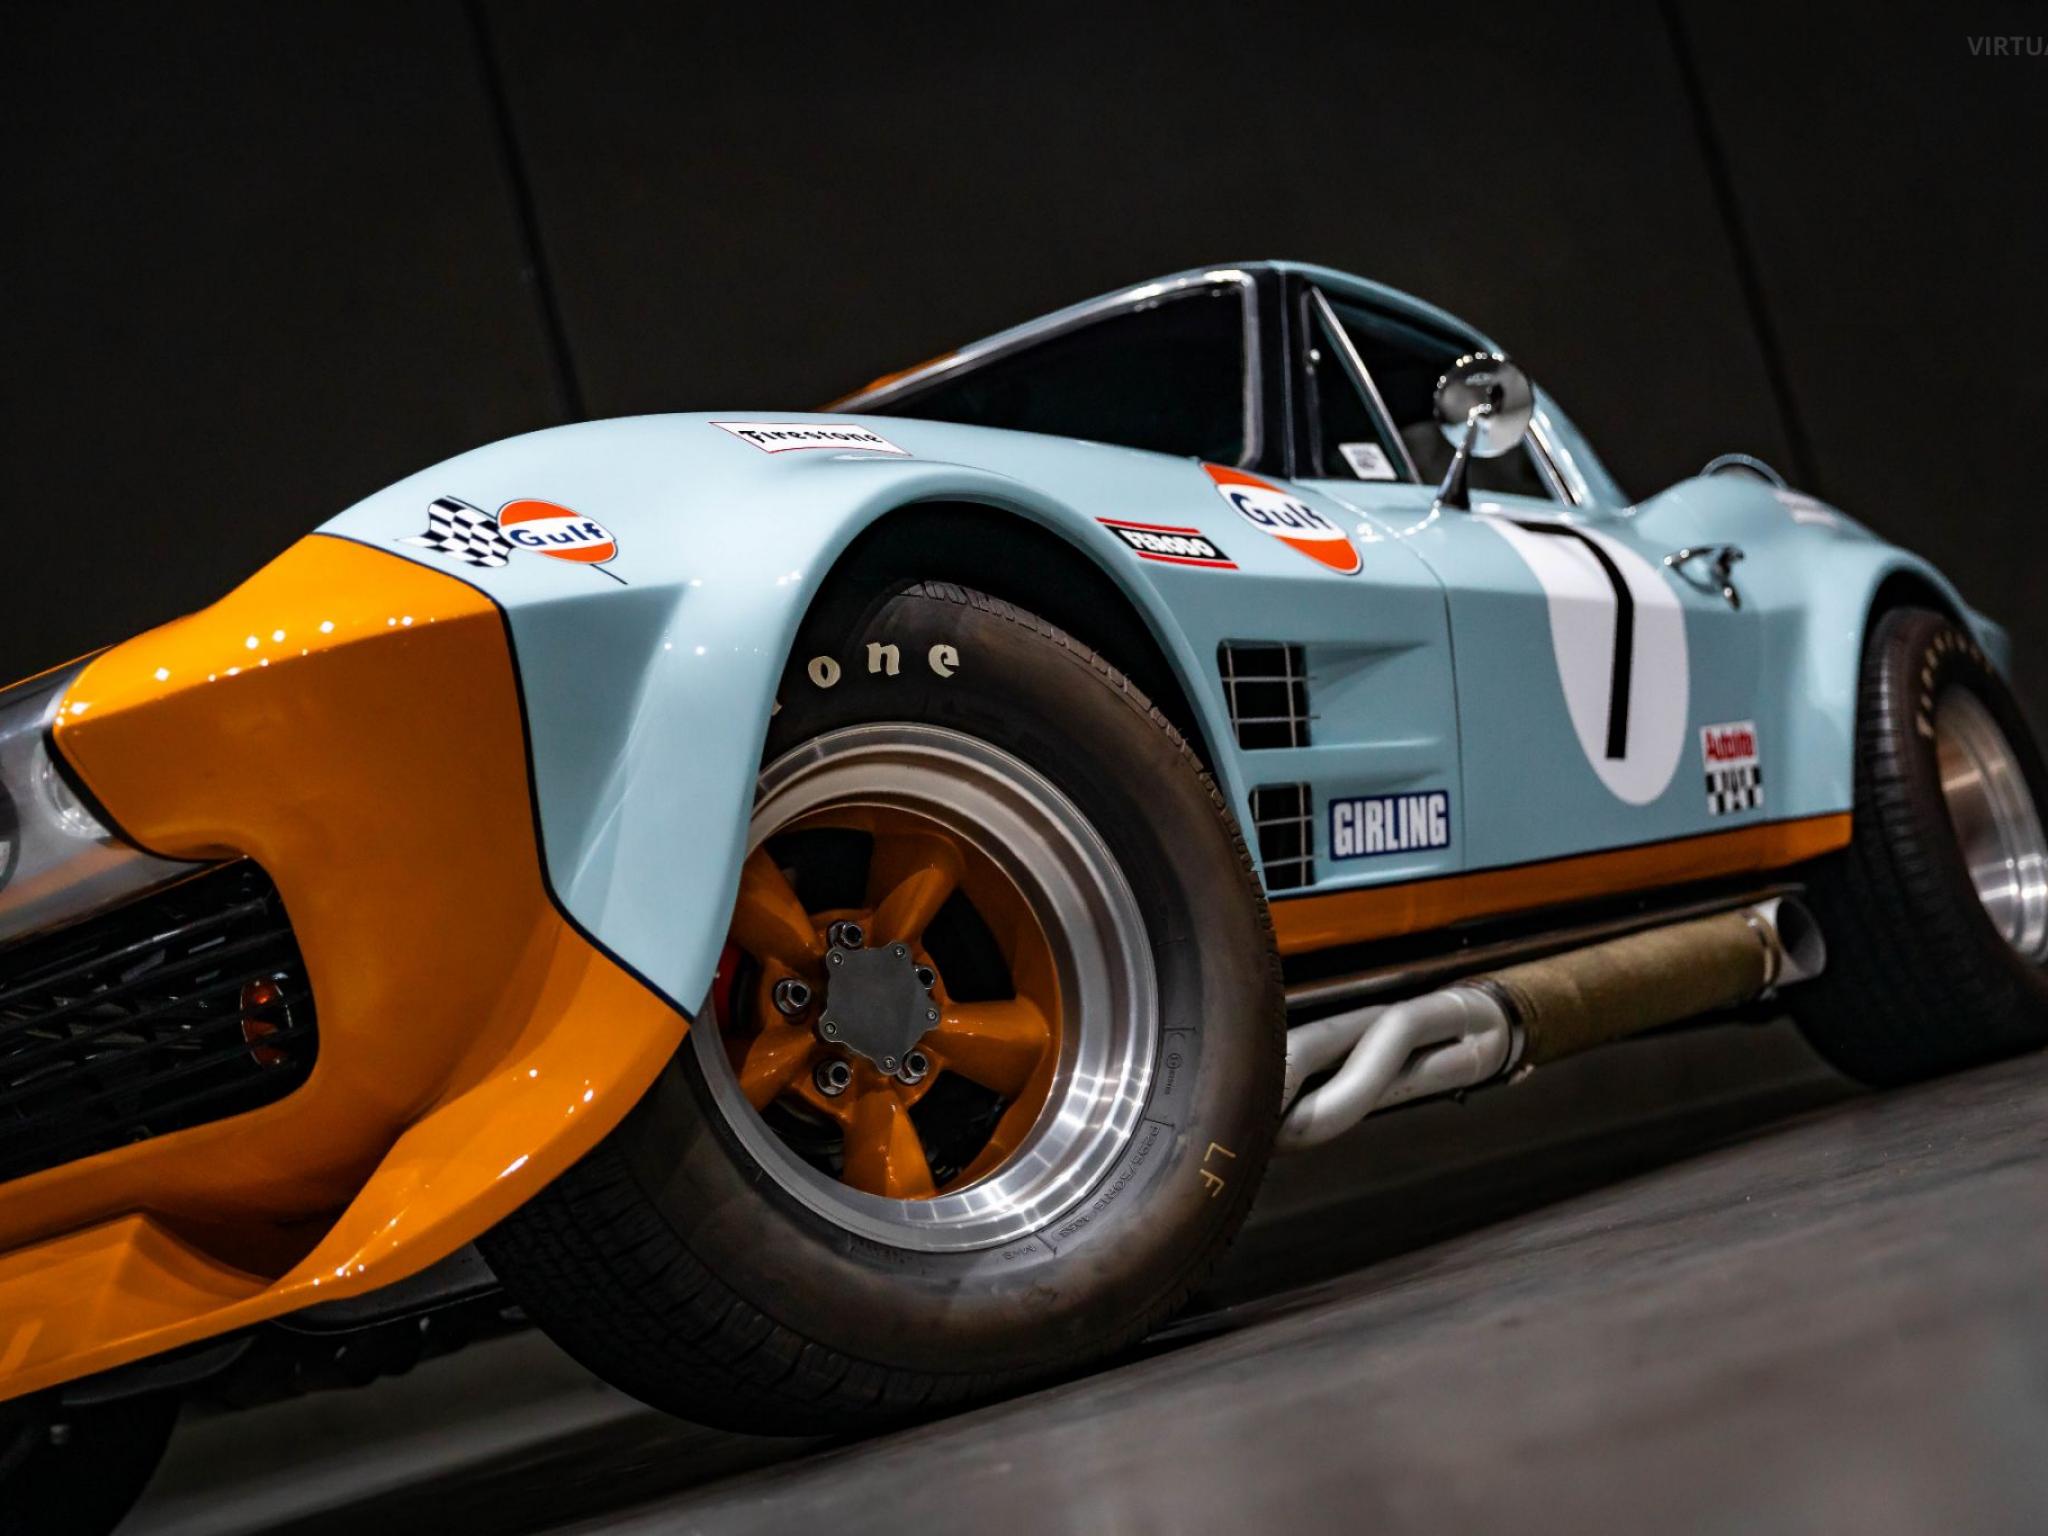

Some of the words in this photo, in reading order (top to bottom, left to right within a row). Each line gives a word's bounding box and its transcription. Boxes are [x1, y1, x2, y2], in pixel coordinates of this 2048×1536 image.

[738, 430, 883, 443] Firestone
[1230, 492, 1332, 530] Gulf
[509, 523, 604, 546] Gulf
[1509, 519, 1635, 760] 7
[1333, 793, 1447, 857] GIRLING
